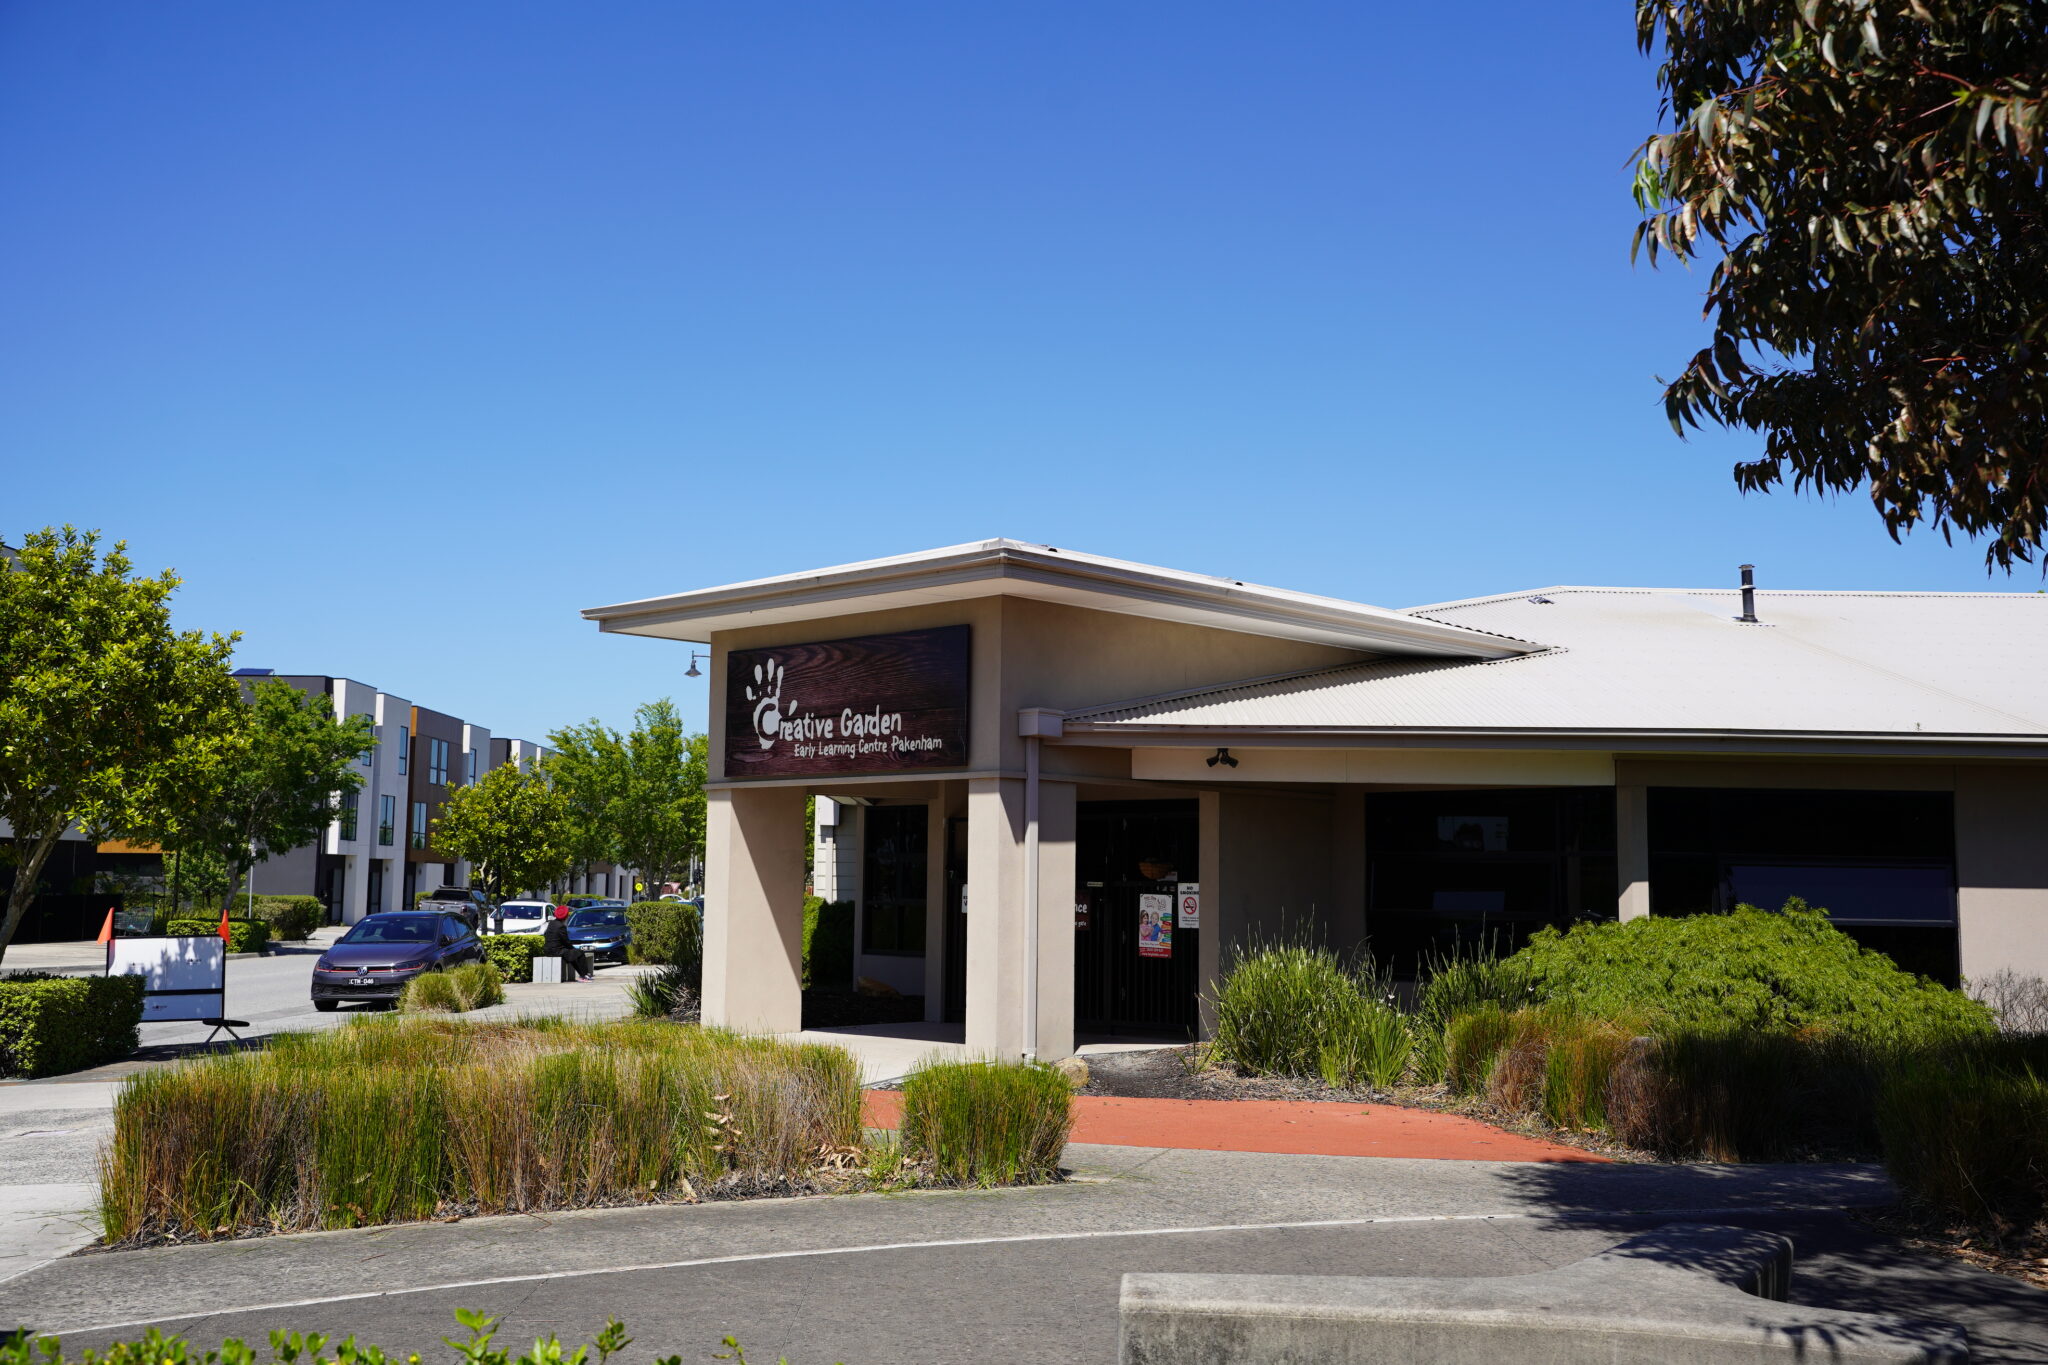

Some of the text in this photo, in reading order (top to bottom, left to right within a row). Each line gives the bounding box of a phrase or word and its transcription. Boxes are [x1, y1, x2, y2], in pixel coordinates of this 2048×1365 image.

[754, 699, 902, 744] Creative Garden
[794, 734, 942, 759] Early Learning Centre Pakenham
